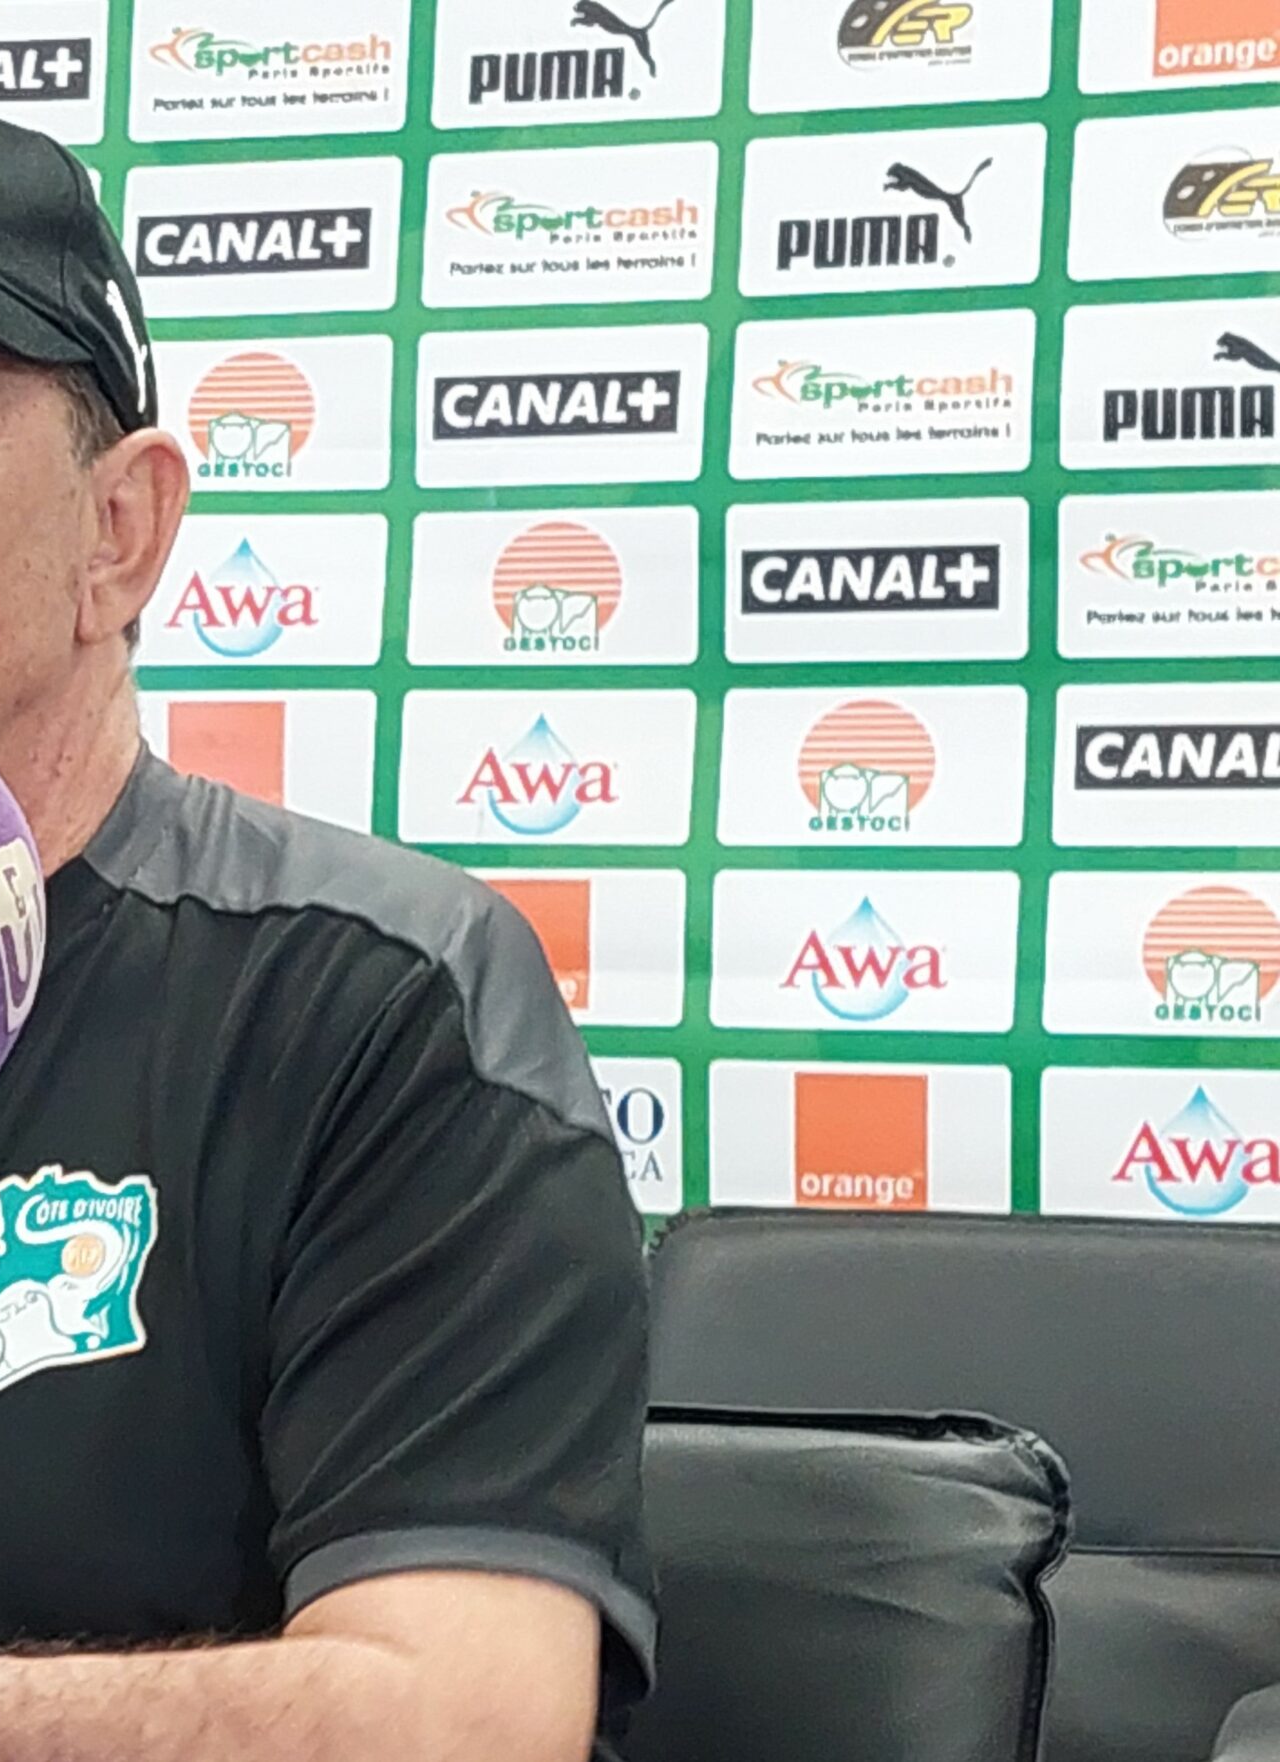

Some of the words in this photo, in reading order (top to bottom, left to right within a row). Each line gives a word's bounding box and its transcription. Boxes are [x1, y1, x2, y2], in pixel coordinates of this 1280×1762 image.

[194, 34, 392, 76] sportcash
[469, 47, 624, 105] PUMA
[1158, 37, 1278, 71] orange
[144, 218, 362, 265] CANAL+
[493, 198, 699, 241] sportcash
[777, 213, 939, 271] PUMA
[442, 378, 670, 428] CANAL+
[800, 367, 1013, 410] sportcash
[1103, 384, 1275, 442] PUMA
[197, 462, 291, 478] GESTOCI
[163, 571, 318, 629] Awa
[750, 553, 990, 603] CANAL+
[504, 635, 599, 651] GESTOCI
[455, 747, 618, 805] Awa
[809, 816, 910, 832] GESTOCI
[779, 929, 948, 990] Awa
[1155, 1004, 1261, 1021] GESTOCI
[1111, 1120, 1280, 1184] Awa
[801, 1172, 915, 1204] orange
